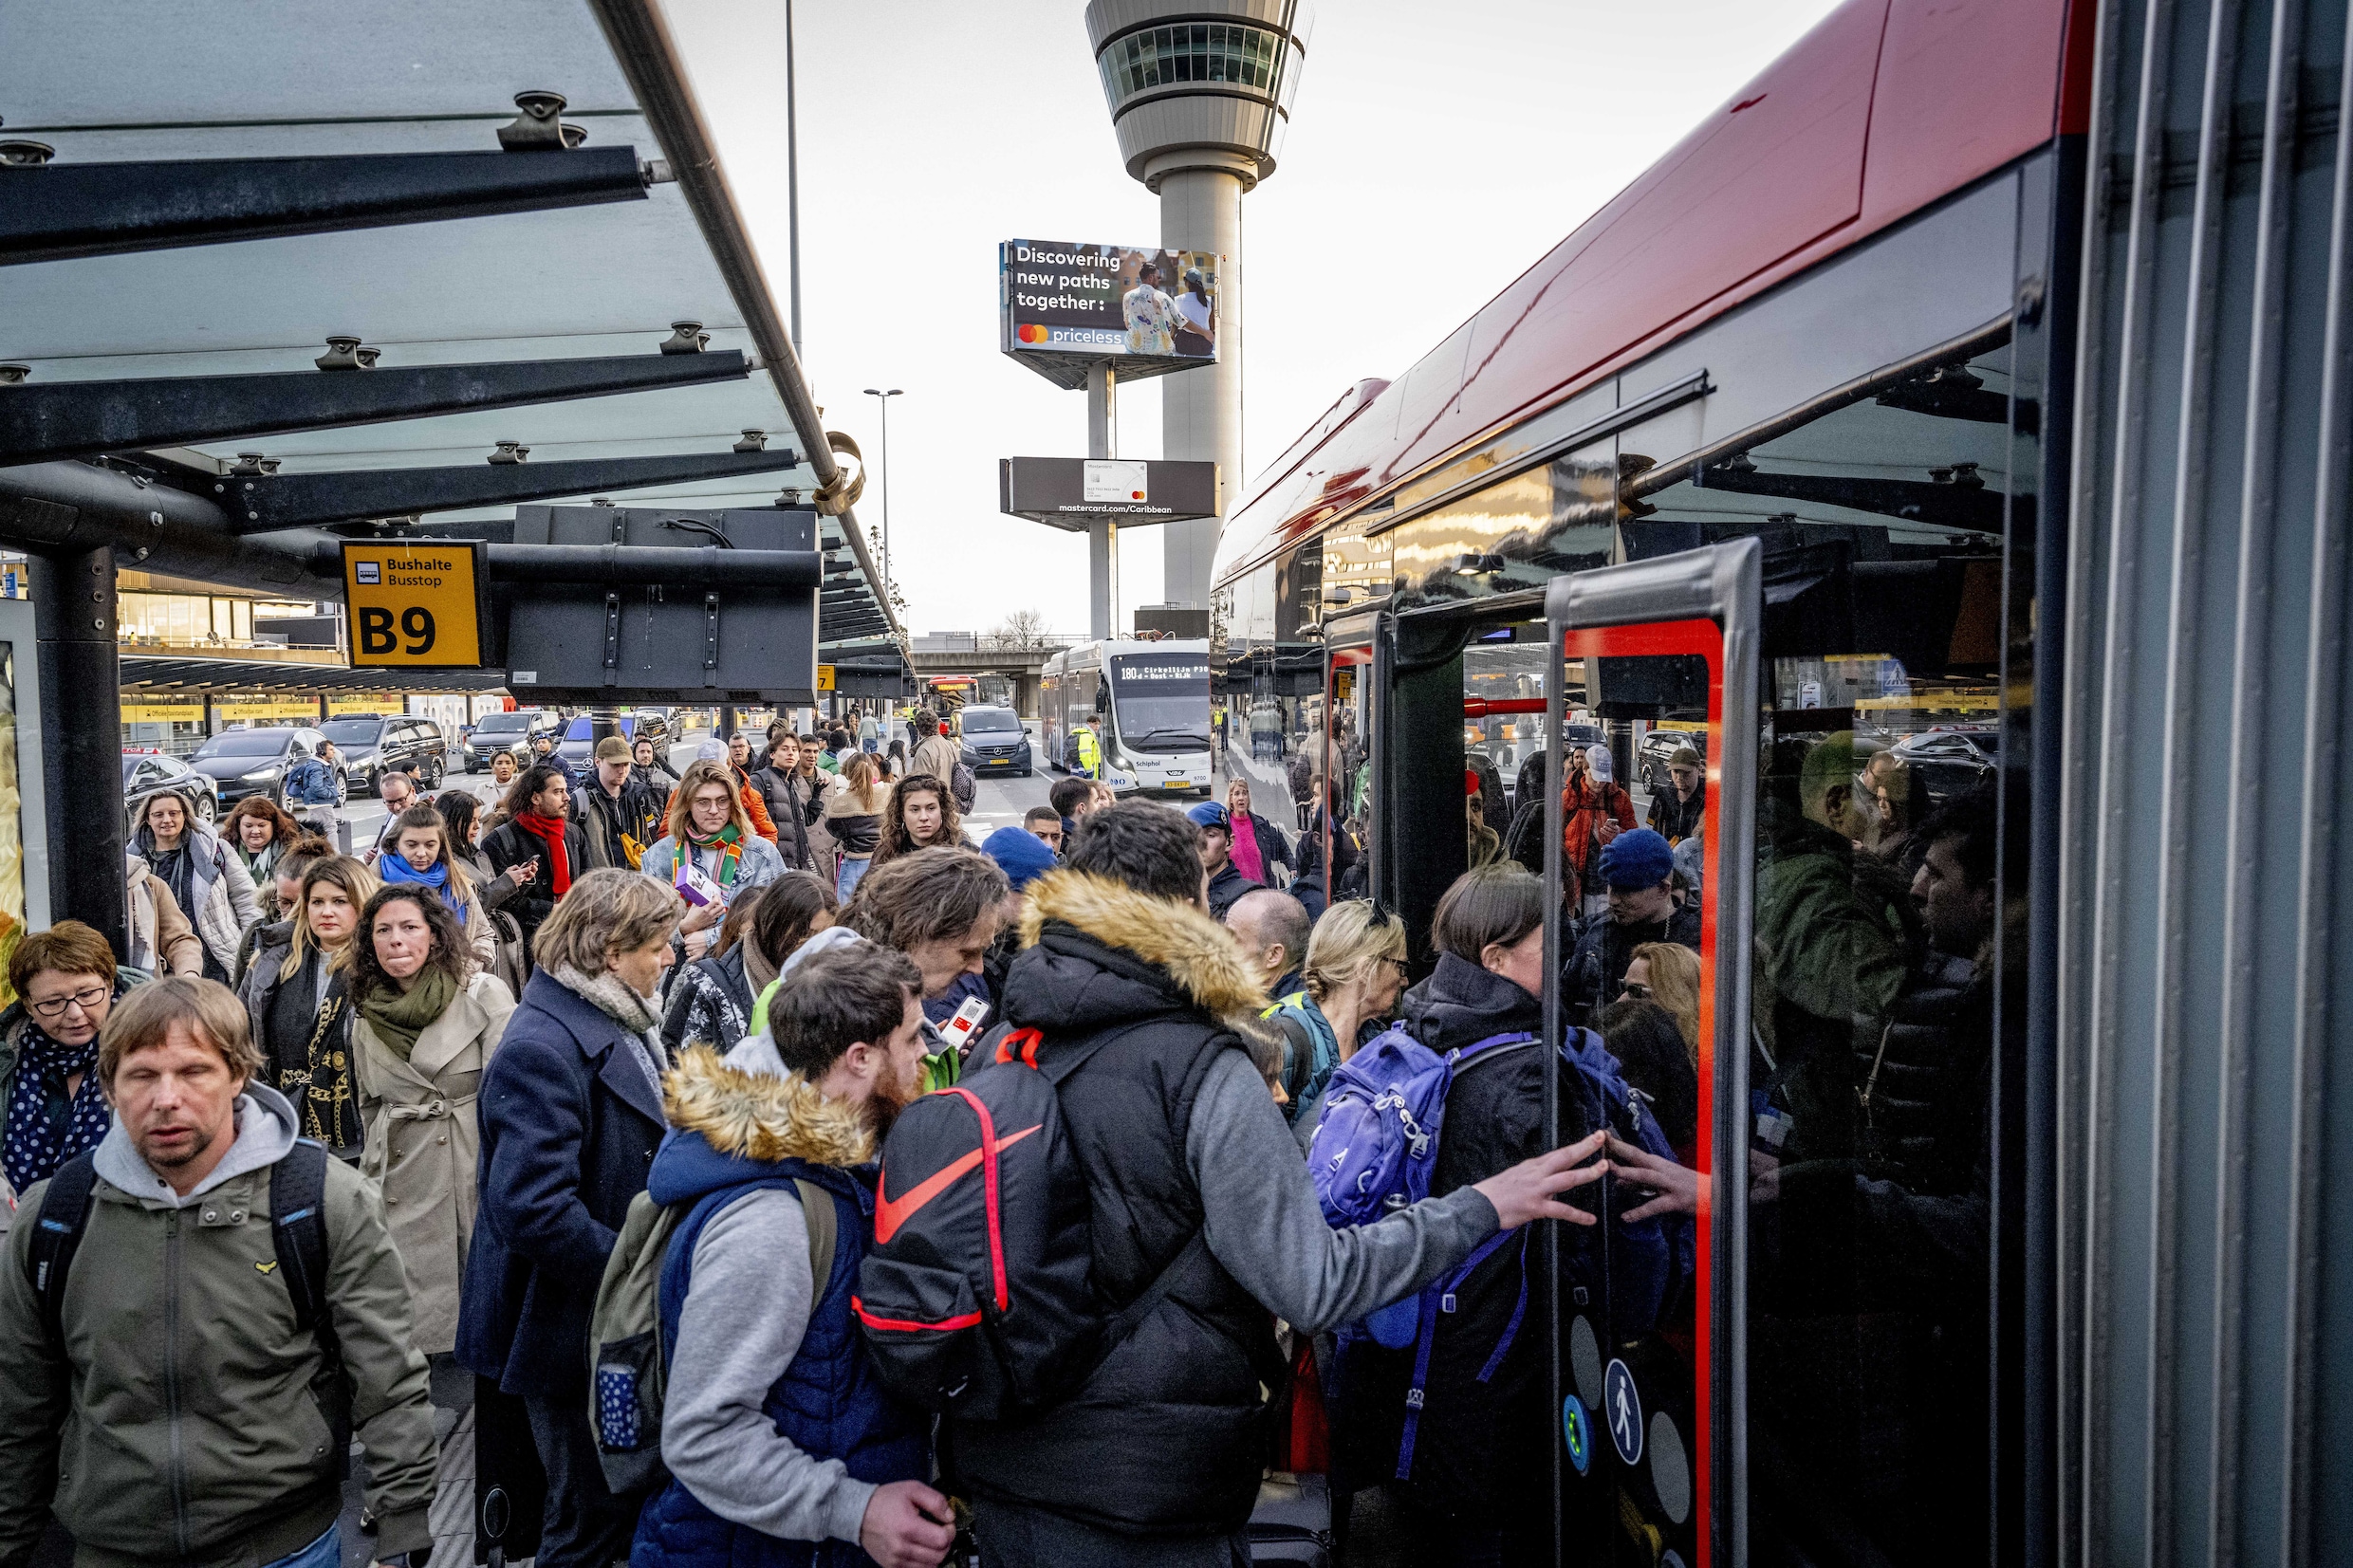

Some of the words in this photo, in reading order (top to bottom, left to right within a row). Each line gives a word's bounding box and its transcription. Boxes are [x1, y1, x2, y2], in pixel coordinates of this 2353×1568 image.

[1016, 247, 1121, 272] Discovering
[1016, 271, 1054, 286] new
[1059, 273, 1111, 290] paths
[1053, 328, 1122, 344] priceless
[1059, 505, 1173, 514] mastercard.com/Caribbean
[387, 559, 453, 571] Bushalte
[388, 575, 442, 588] Busstop
[359, 606, 436, 655] B9
[1121, 667, 1137, 680] 180
